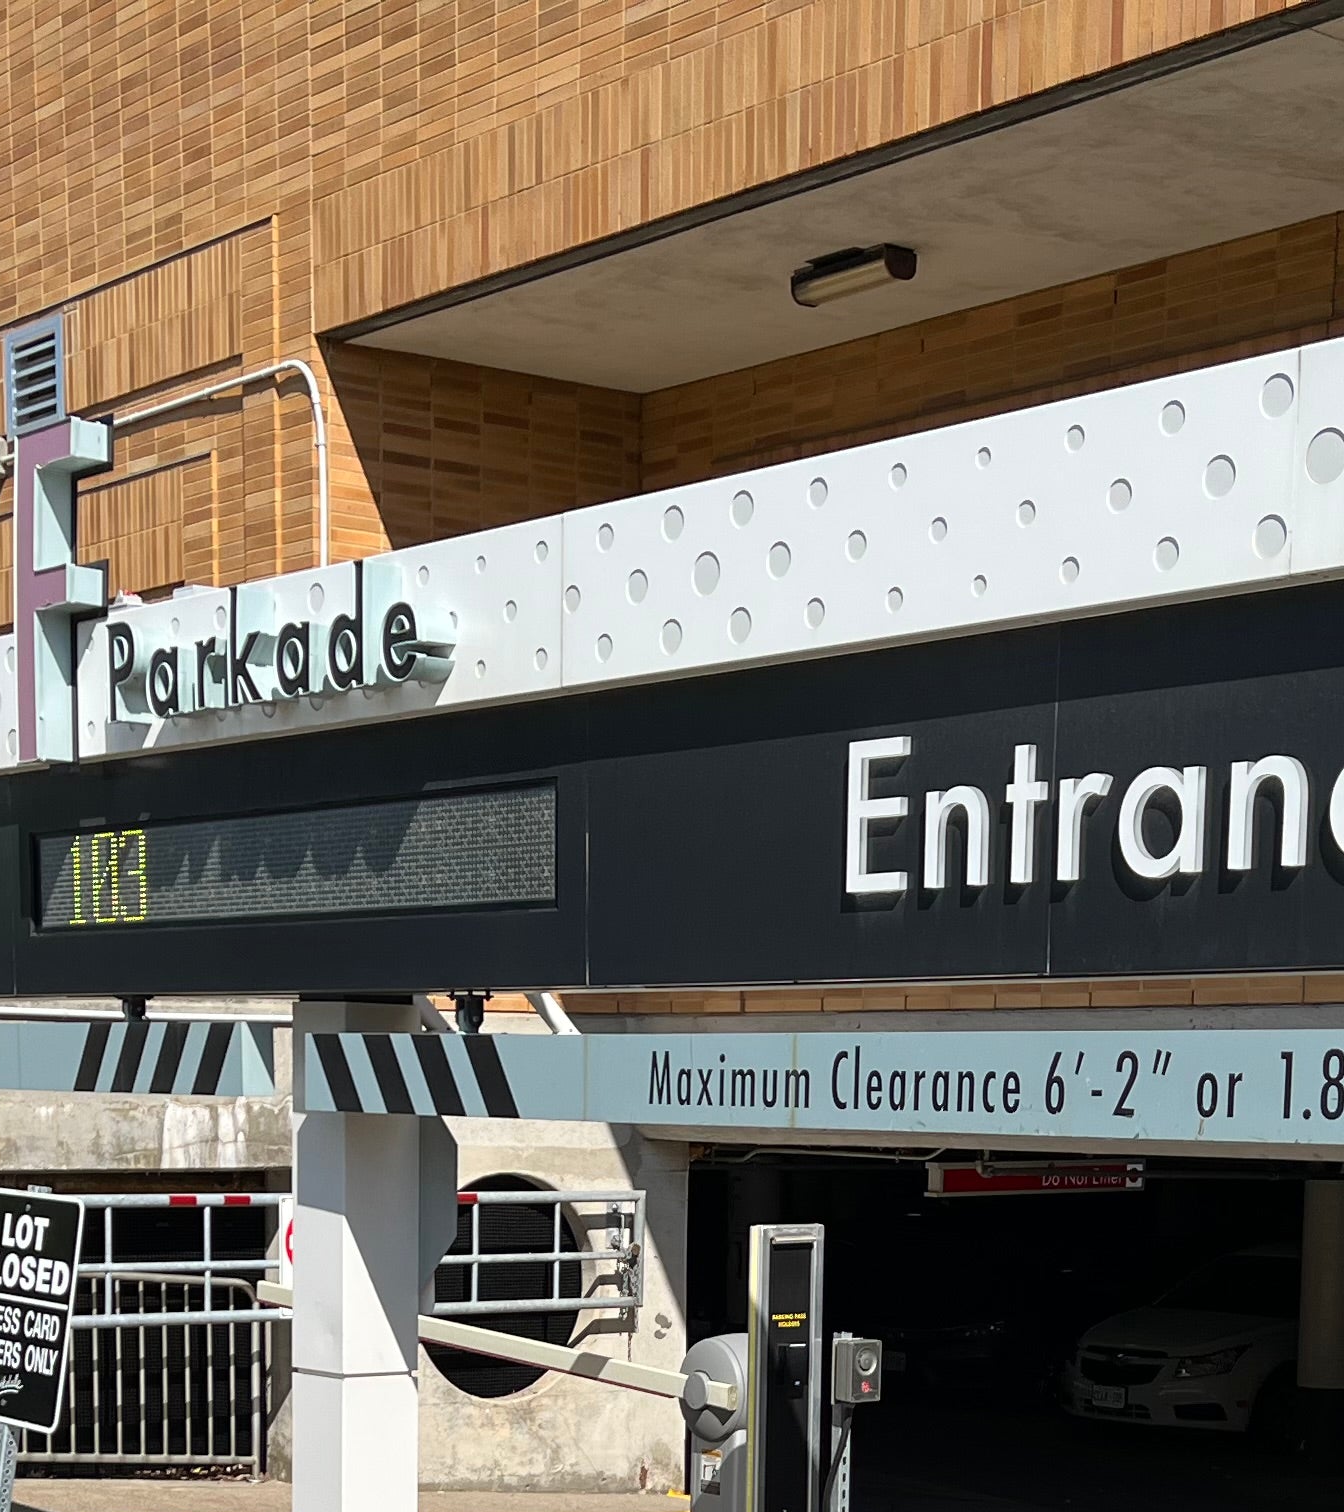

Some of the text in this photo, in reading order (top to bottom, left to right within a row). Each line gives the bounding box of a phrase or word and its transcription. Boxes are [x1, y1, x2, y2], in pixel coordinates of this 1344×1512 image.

[106, 559, 431, 722] Parkade
[69, 829, 147, 924] 103
[649, 1050, 810, 1108] Maximum
[831, 1045, 1021, 1113] Clearance
[1196, 1072, 1244, 1118] or
[1, 1212, 50, 1251] LOT
[23, 1310, 60, 1342] CARD
[24, 1344, 58, 1376] ONLY
